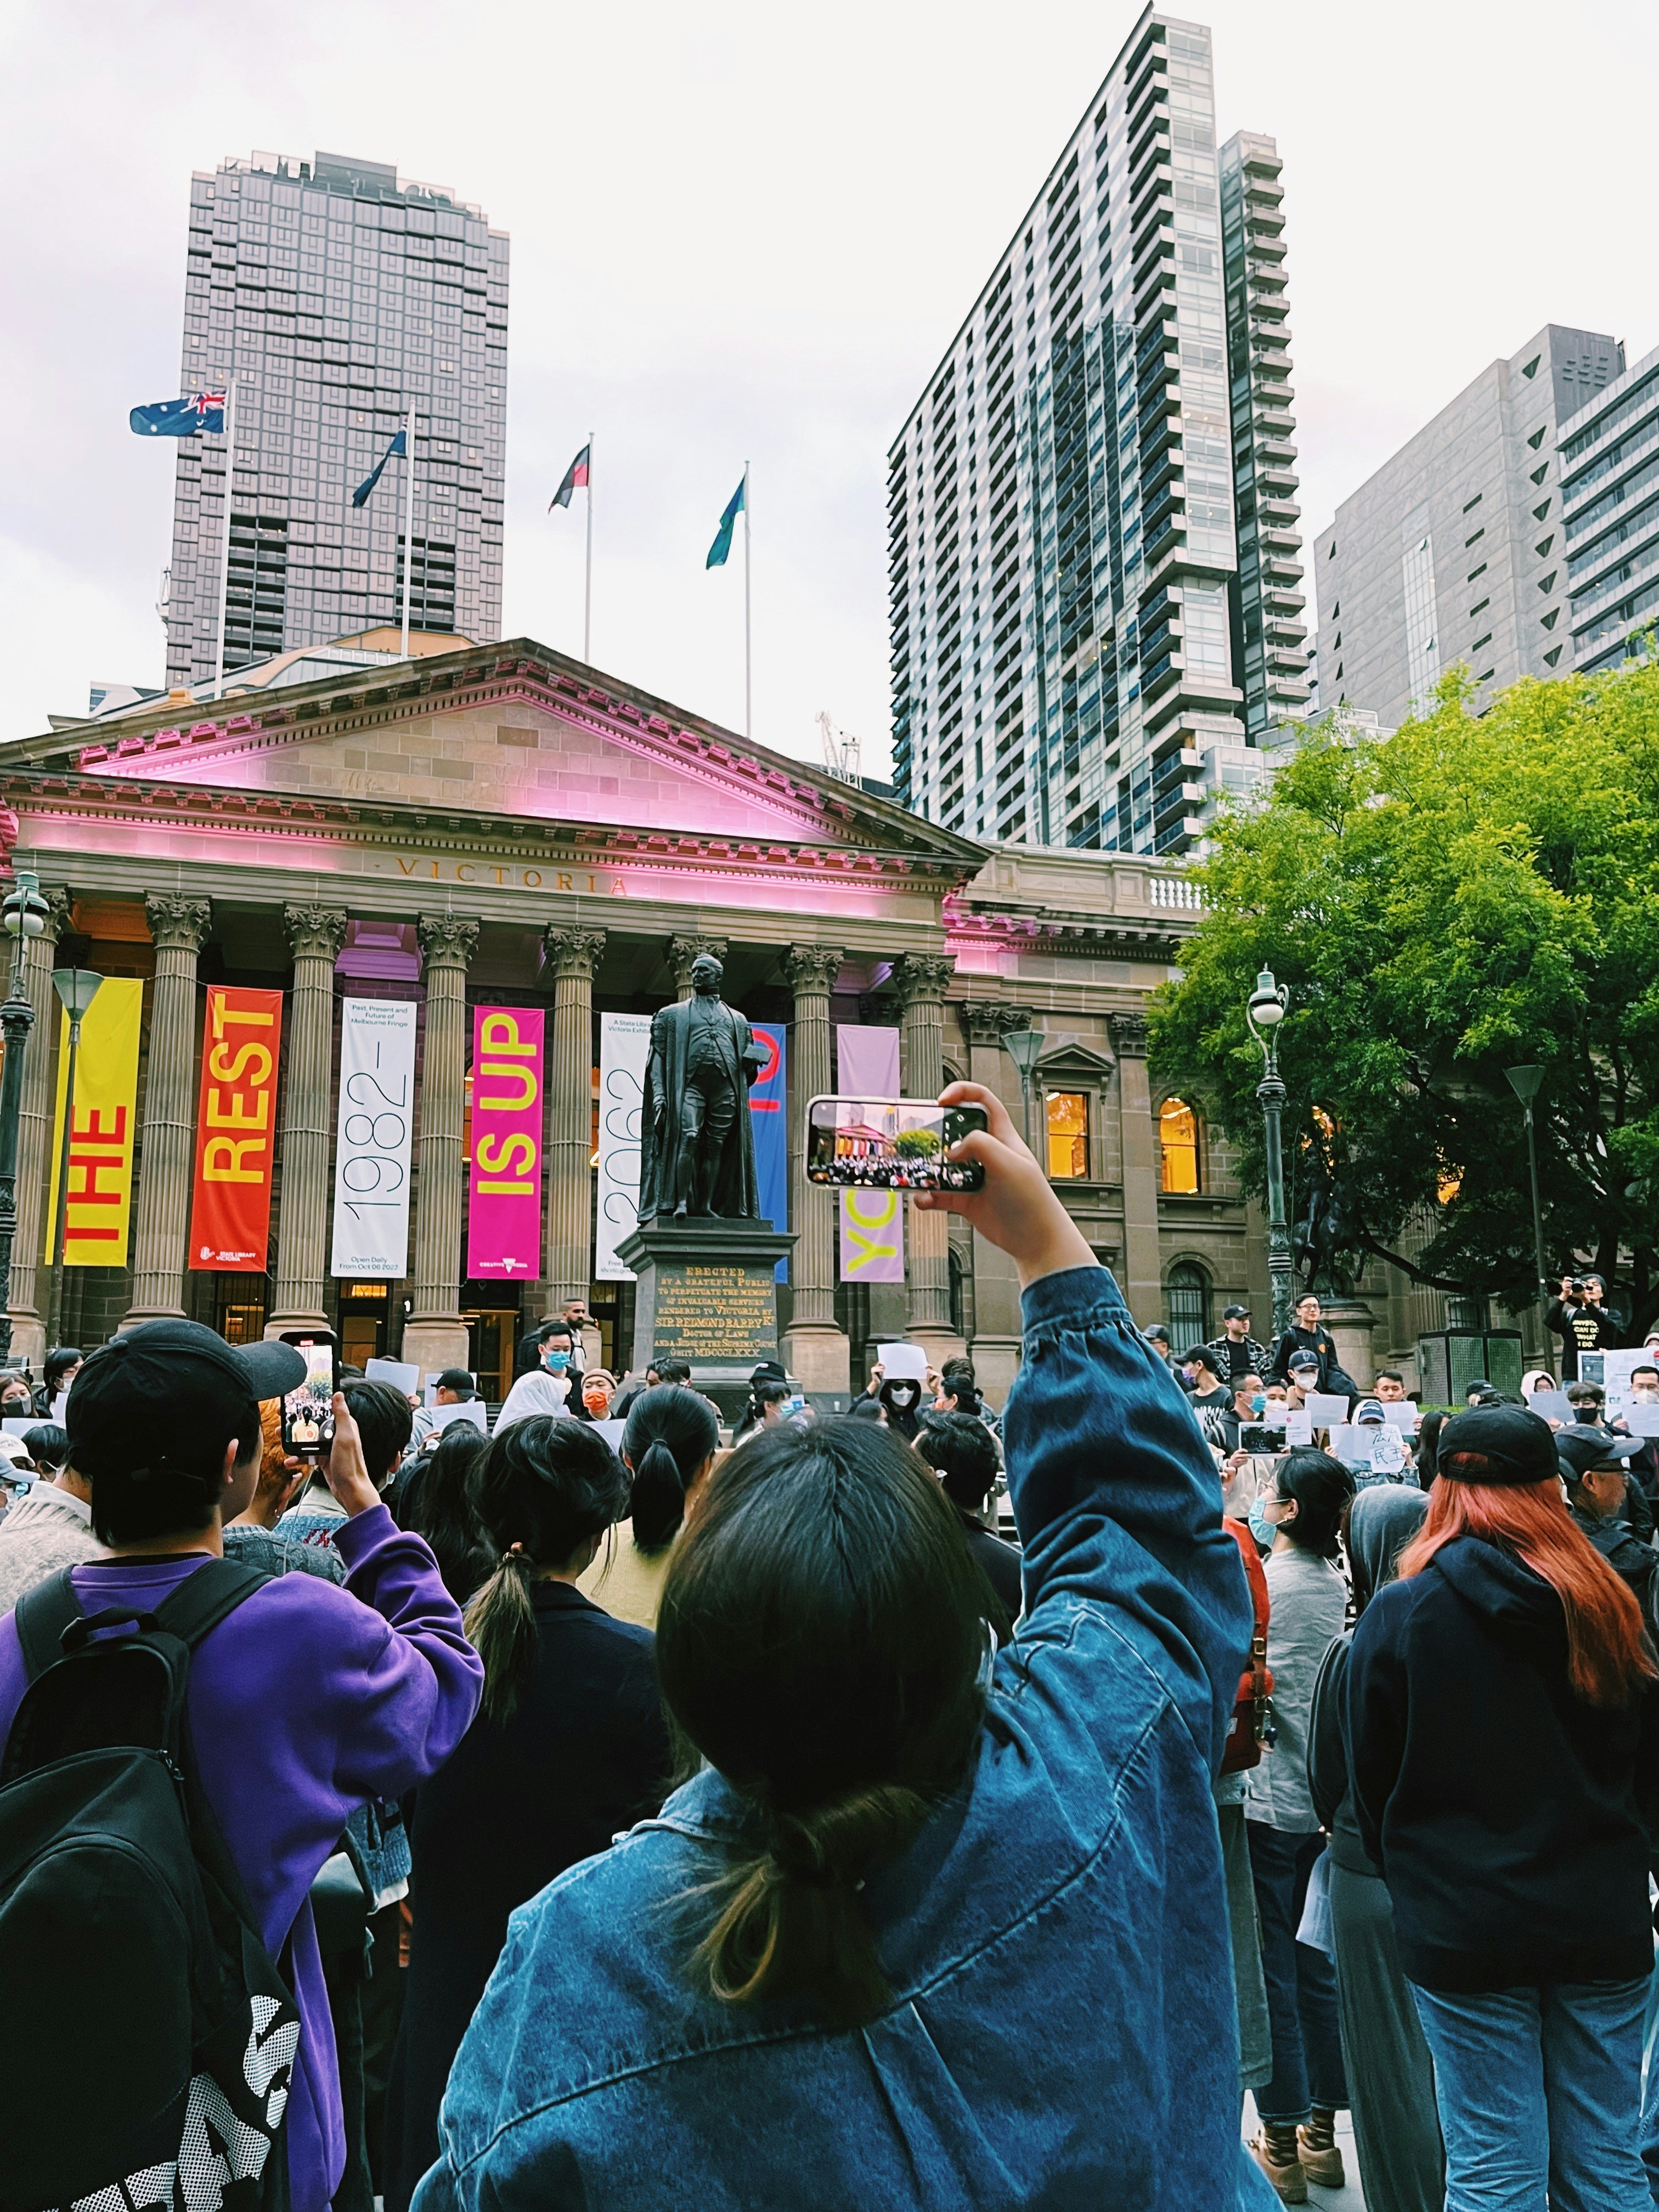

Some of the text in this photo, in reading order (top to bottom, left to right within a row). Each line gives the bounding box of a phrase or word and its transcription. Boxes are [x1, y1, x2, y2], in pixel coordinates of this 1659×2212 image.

[396, 857, 627, 896] VICTORIA
[202, 993, 274, 1184] REST
[476, 1013, 537, 1195] IS UP
[63, 1104, 127, 1256] THE
[686, 1267, 745, 1277] ERECTED
[654, 1317, 675, 1327] SIR
